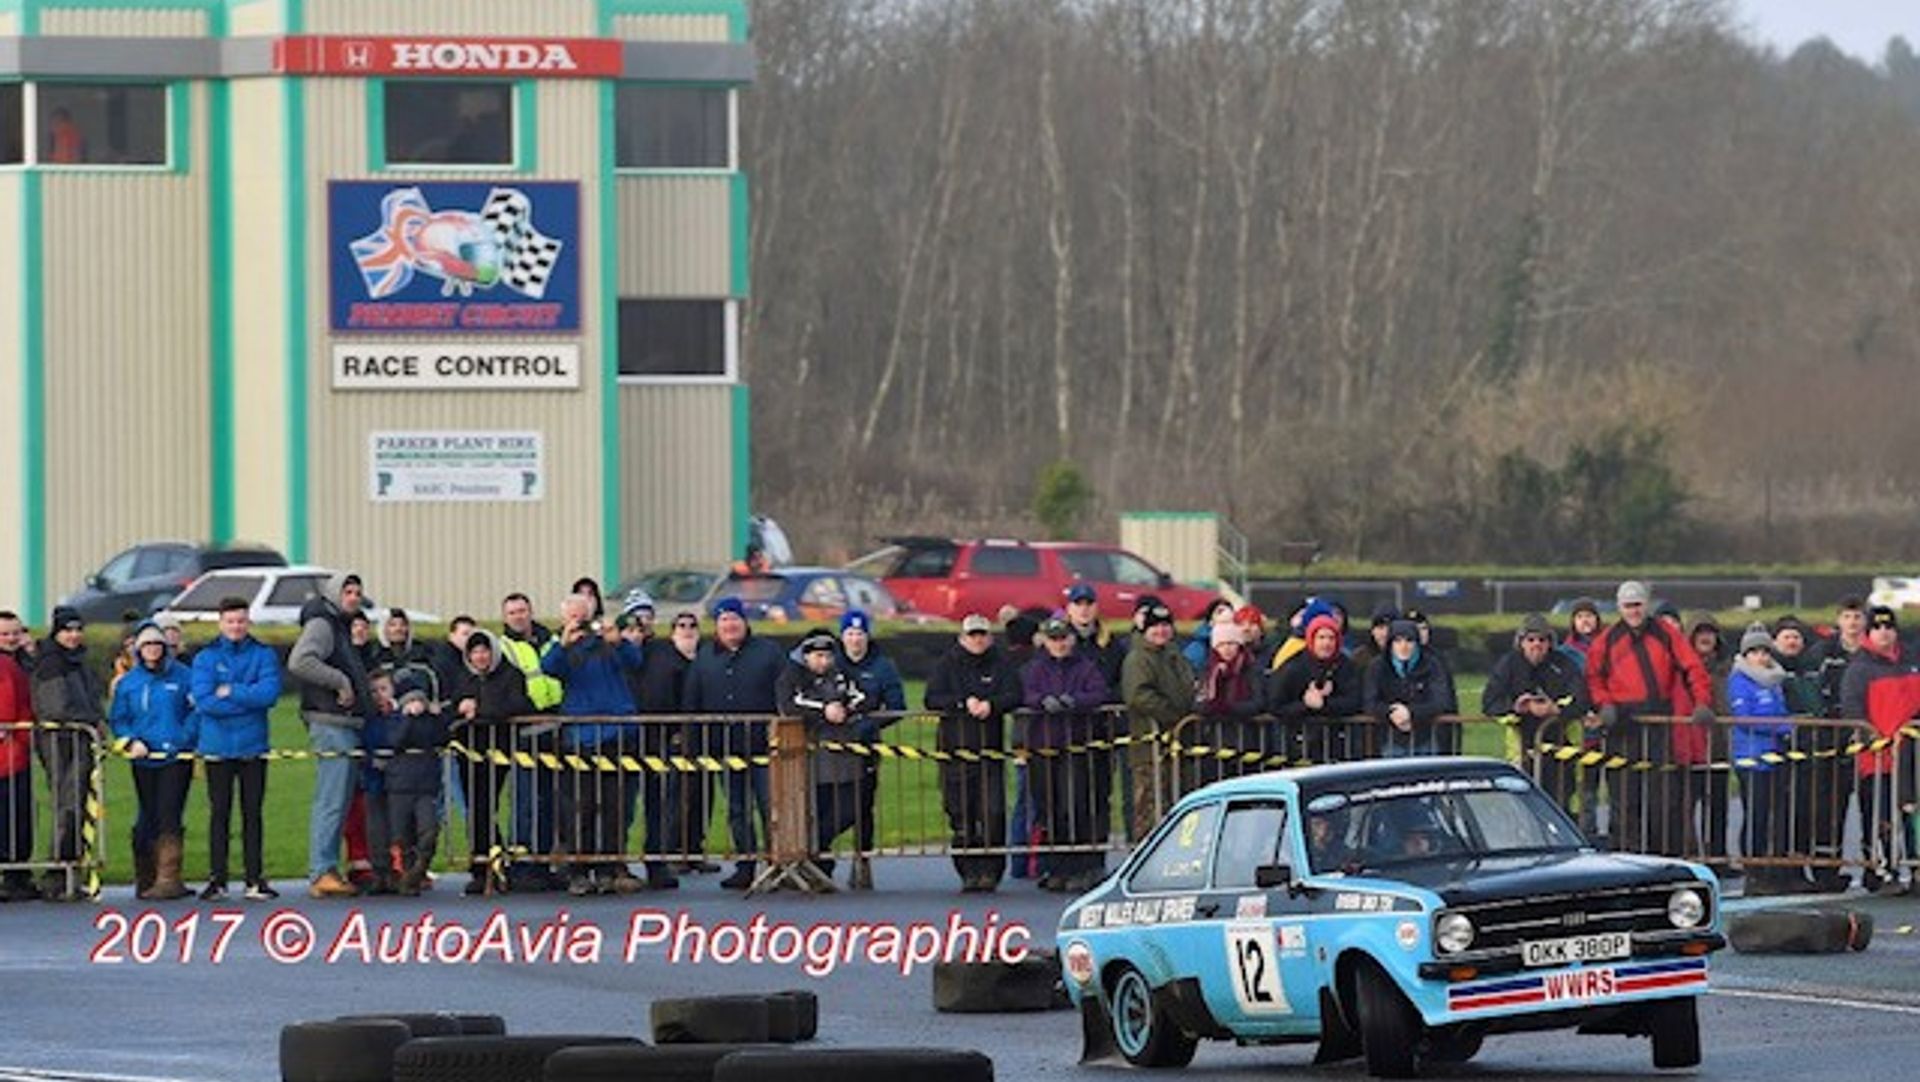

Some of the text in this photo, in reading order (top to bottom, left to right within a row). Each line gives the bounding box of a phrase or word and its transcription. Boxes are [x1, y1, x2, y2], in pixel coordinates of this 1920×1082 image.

[392, 43, 577, 70] HONDA
[343, 356, 567, 377] RACE CONTROL
[376, 437, 438, 450] PARKER
[443, 437, 493, 450] PLANT
[1529, 943, 1568, 963] OKK
[1235, 938, 1274, 1003] 12
[1546, 969, 1613, 1000] WWRS
